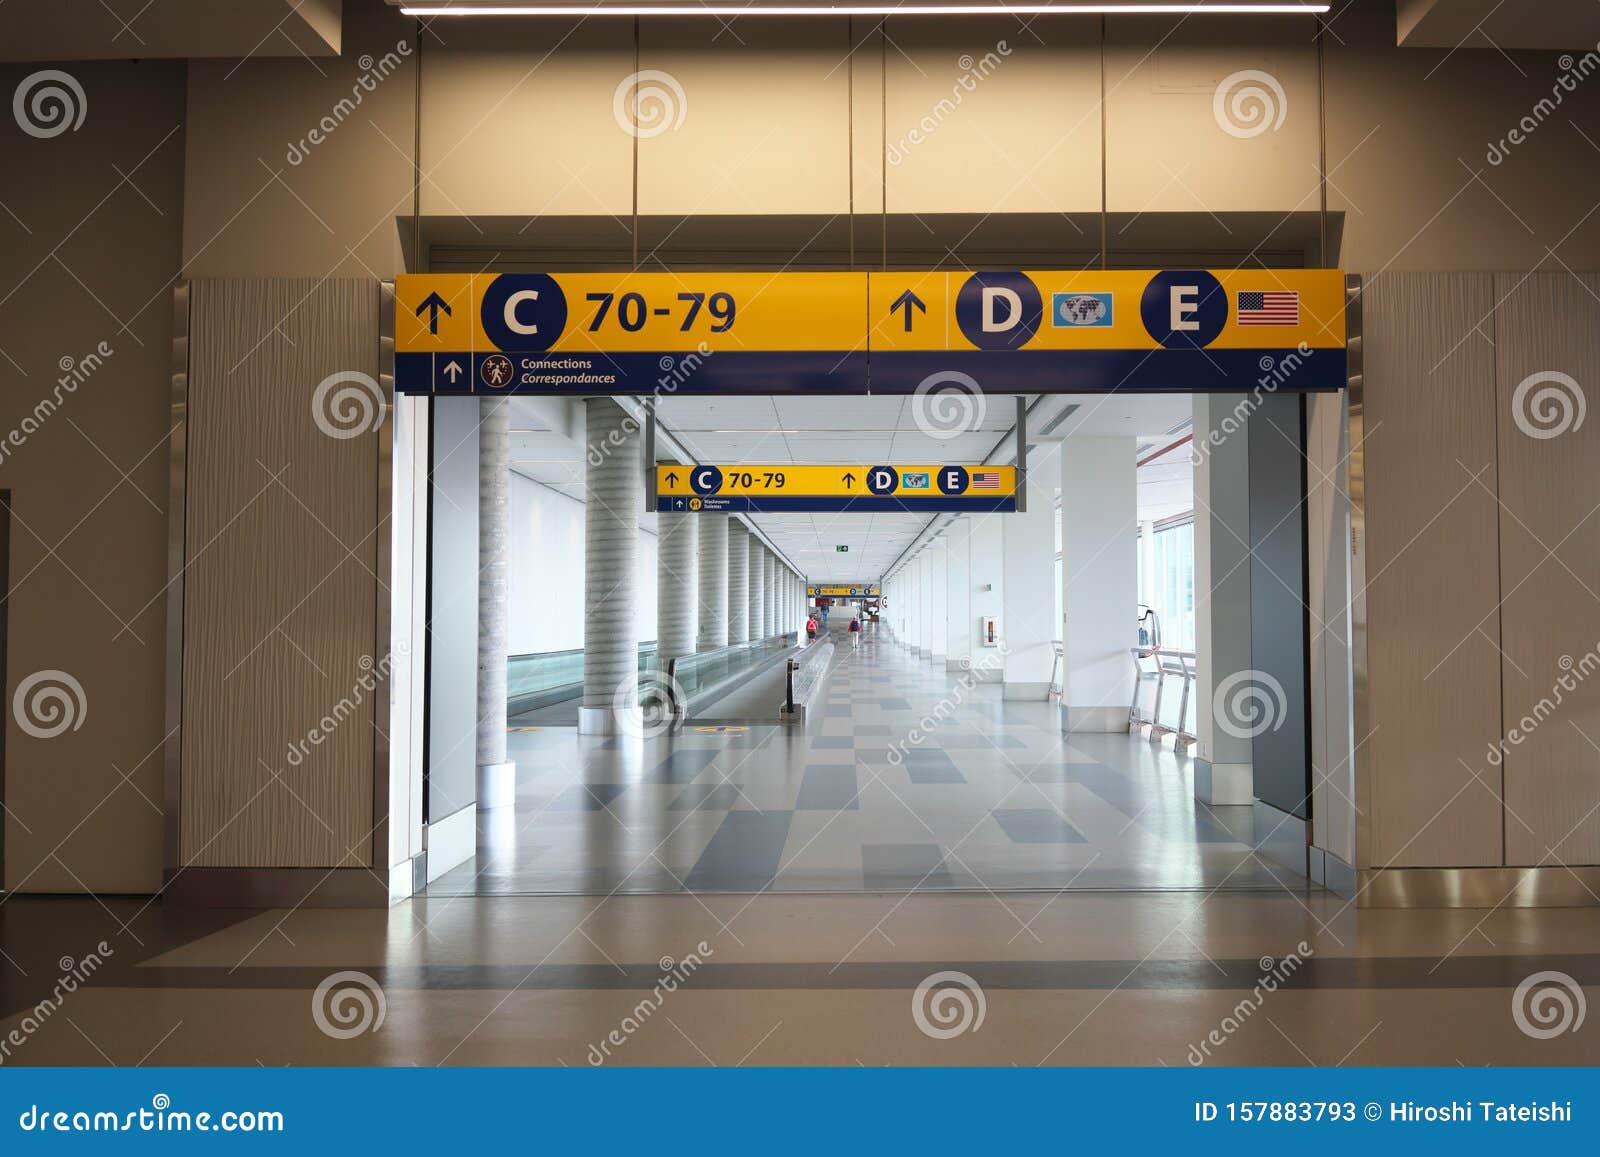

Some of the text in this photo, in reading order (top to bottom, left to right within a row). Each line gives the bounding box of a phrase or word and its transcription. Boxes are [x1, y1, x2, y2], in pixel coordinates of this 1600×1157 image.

[503, 289, 539, 335] C
[981, 285, 1200, 332] D E
[521, 358, 592, 369] Connections
[521, 372, 616, 386] Correspondances
[698, 471, 712, 489] C
[875, 471, 960, 489] D E
